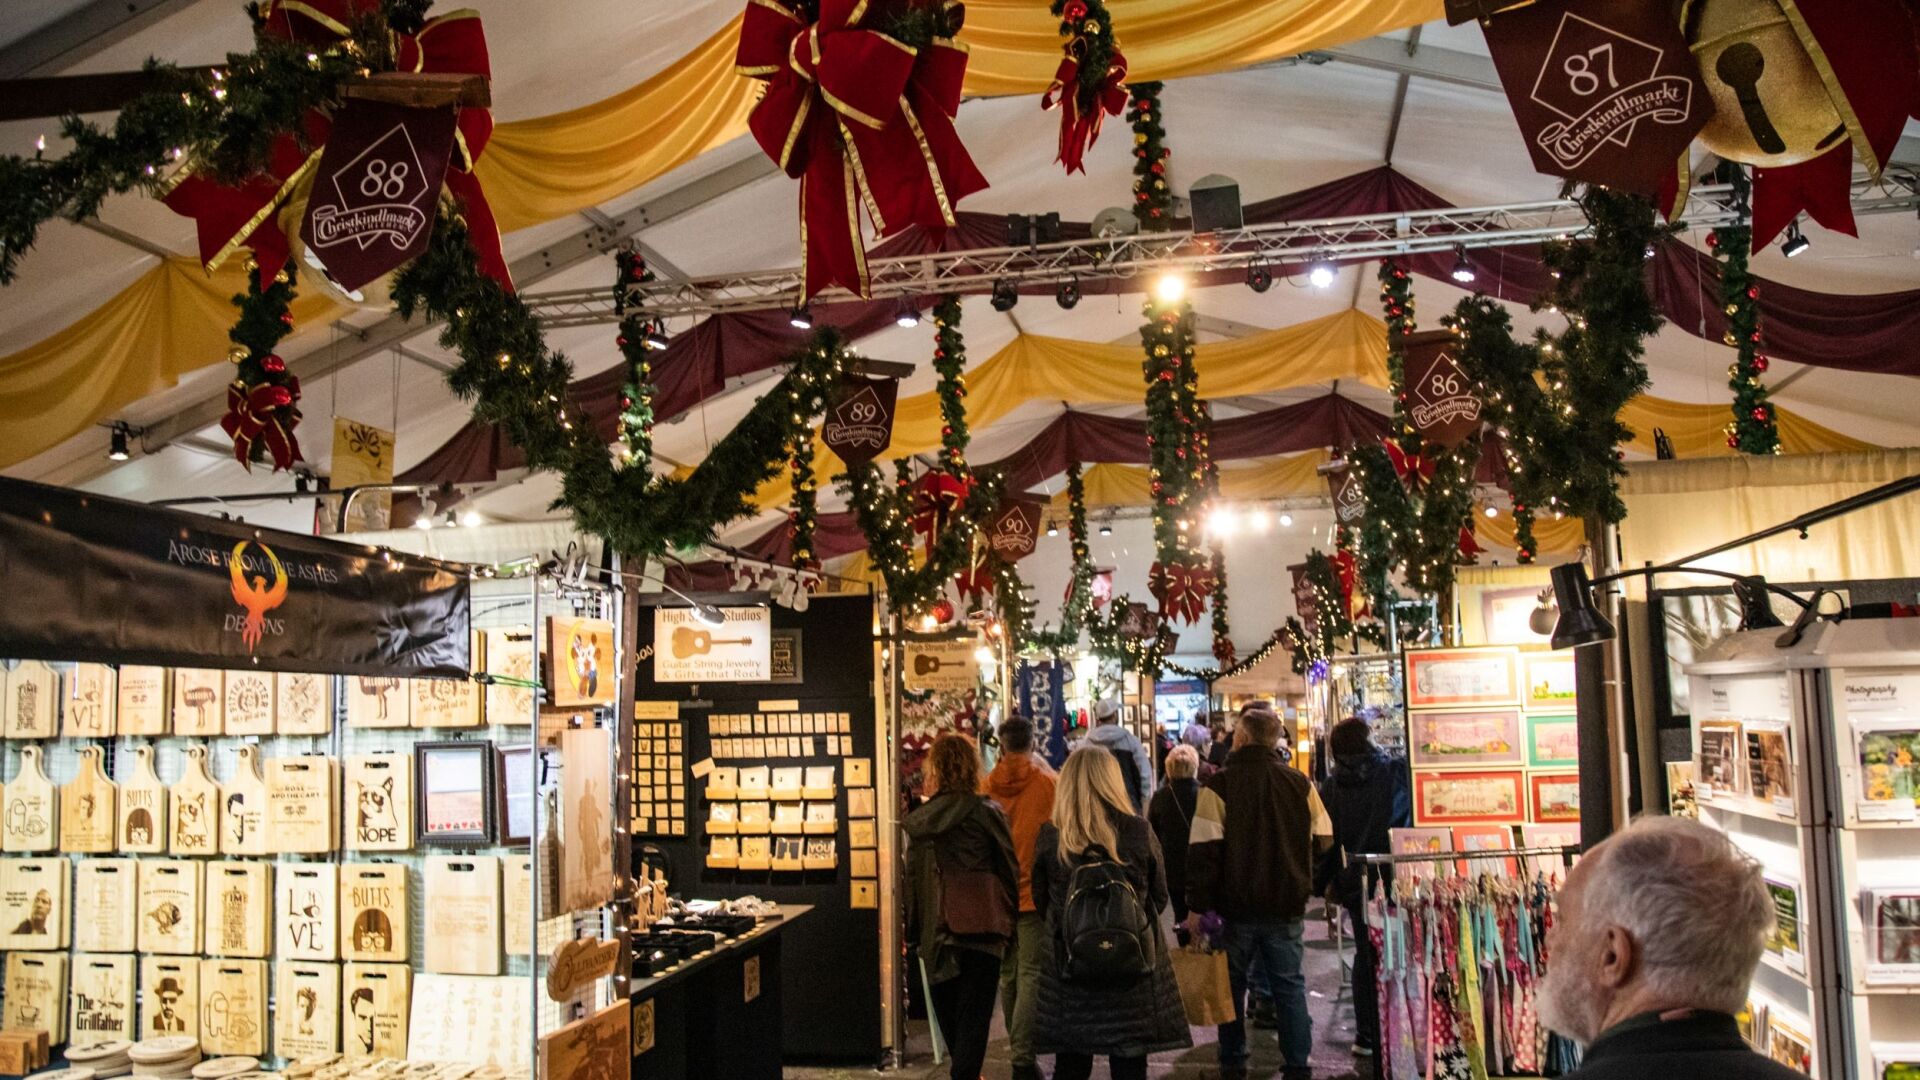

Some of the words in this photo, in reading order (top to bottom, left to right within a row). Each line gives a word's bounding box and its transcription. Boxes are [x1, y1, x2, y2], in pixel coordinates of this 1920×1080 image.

[1564, 43, 1619, 96] 87
[1555, 82, 1683, 160] Christkindlmarkt
[360, 159, 409, 199] 88
[317, 208, 417, 240] Christkindlmarkt
[1432, 372, 1459, 397] 86
[850, 402, 876, 423] 89
[1006, 518, 1024, 534] 90
[168, 539, 222, 566] AROSE
[298, 563, 338, 584] ASHES
[225, 613, 285, 636] DENS
[663, 610, 686, 625] High
[725, 608, 762, 622] Studios
[662, 660, 691, 669] Guitar
[694, 659, 723, 670] String
[726, 659, 761, 669] Jewelry
[662, 670, 670, 679] &
[675, 670, 702, 679] Gifts
[706, 670, 729, 679] that
[734, 669, 762, 678] Rock
[176, 834, 207, 848] NOPE
[357, 827, 396, 843] NOPE
[808, 843, 831, 853] YOU
[76, 993, 95, 1010] The
[76, 1011, 124, 1032] Grillfather
